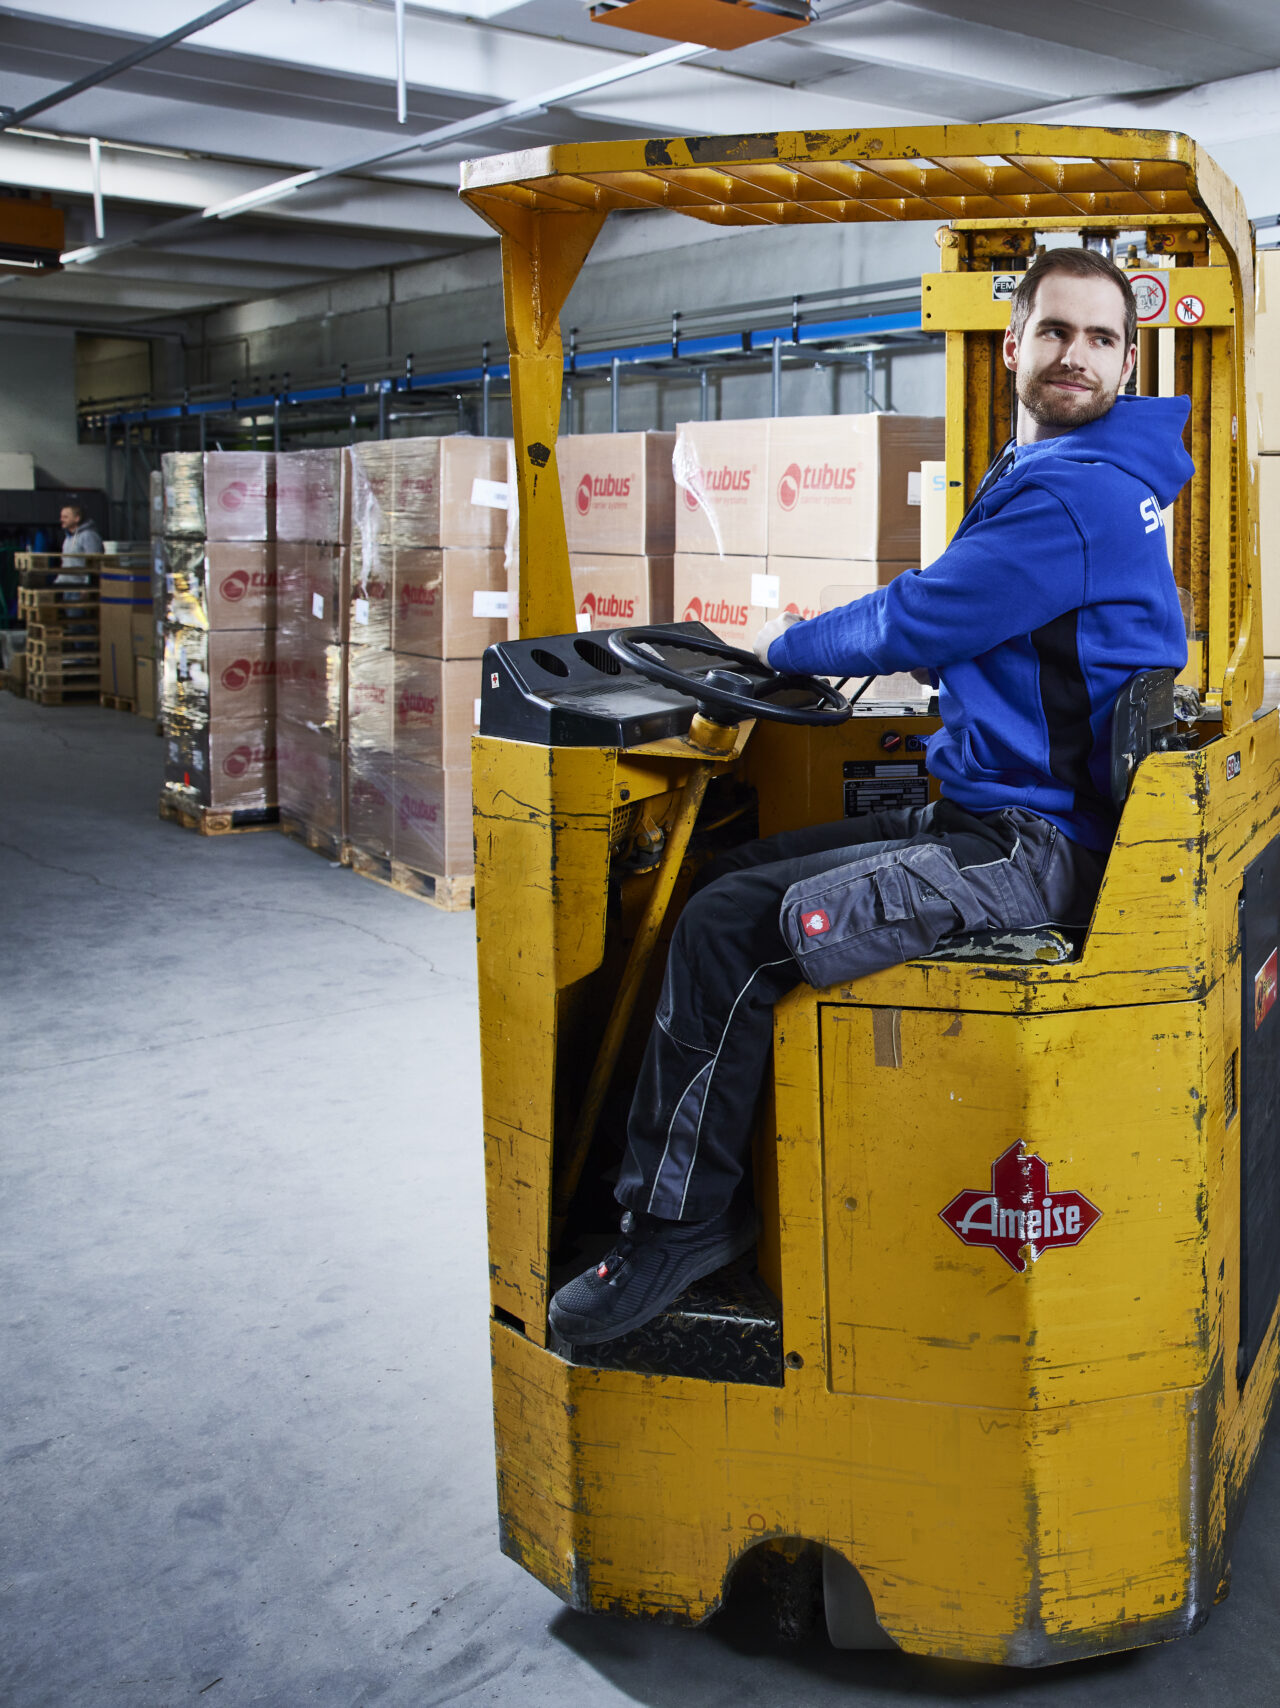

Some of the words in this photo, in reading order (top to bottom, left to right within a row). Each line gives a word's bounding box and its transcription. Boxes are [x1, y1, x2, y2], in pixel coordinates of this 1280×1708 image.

[995, 282, 1014, 290] FEM
[593, 473, 631, 497] tubus
[705, 465, 751, 491] tubus
[803, 463, 857, 490] tubus
[597, 594, 634, 619] tubus
[704, 599, 749, 627] tubus
[956, 1196, 1082, 1241] Ameise
